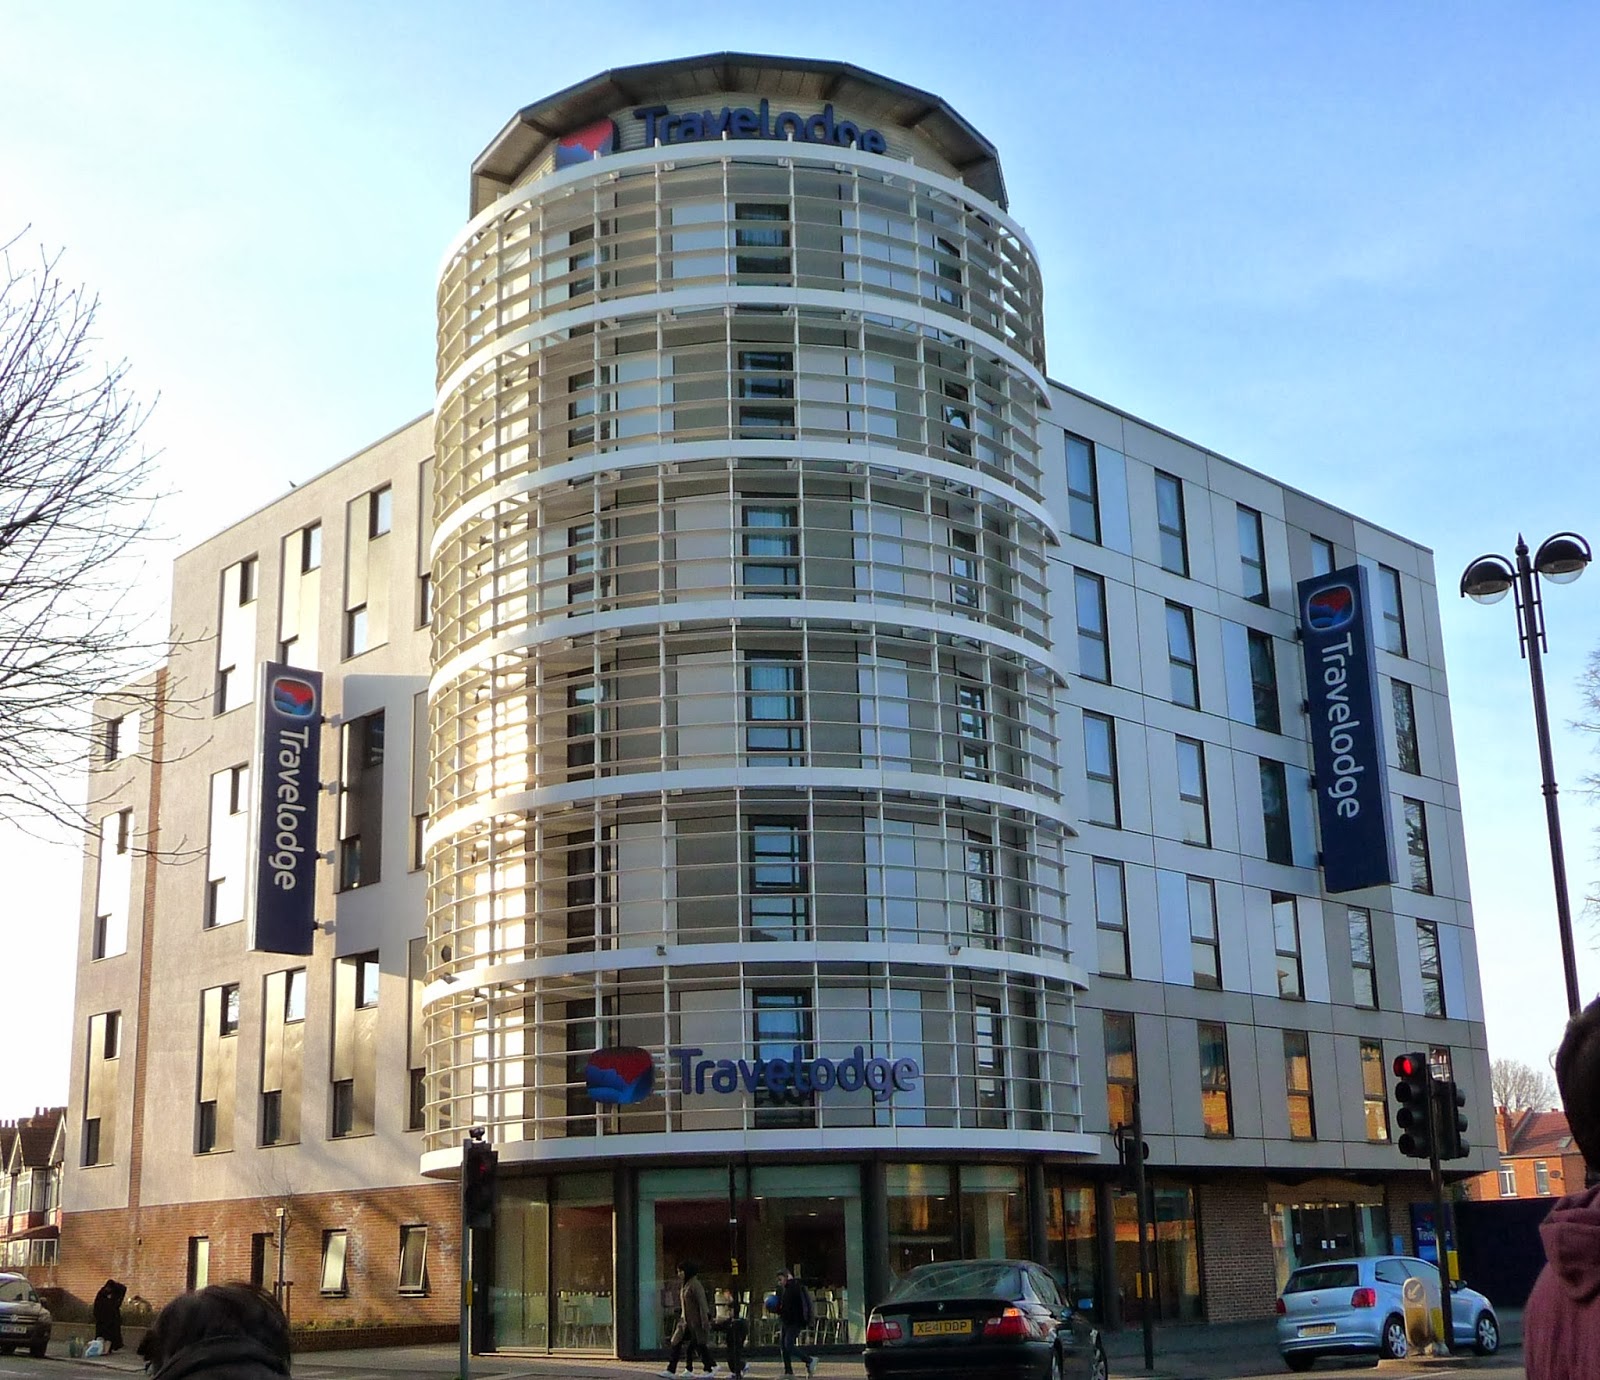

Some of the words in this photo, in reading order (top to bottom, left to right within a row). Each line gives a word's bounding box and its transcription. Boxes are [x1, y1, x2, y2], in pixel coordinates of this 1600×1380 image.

[633, 98, 887, 154] Travelodge
[1322, 632, 1365, 819] Travelodge
[268, 726, 310, 890] Travelodge
[671, 1046, 920, 1101] Travelodge
